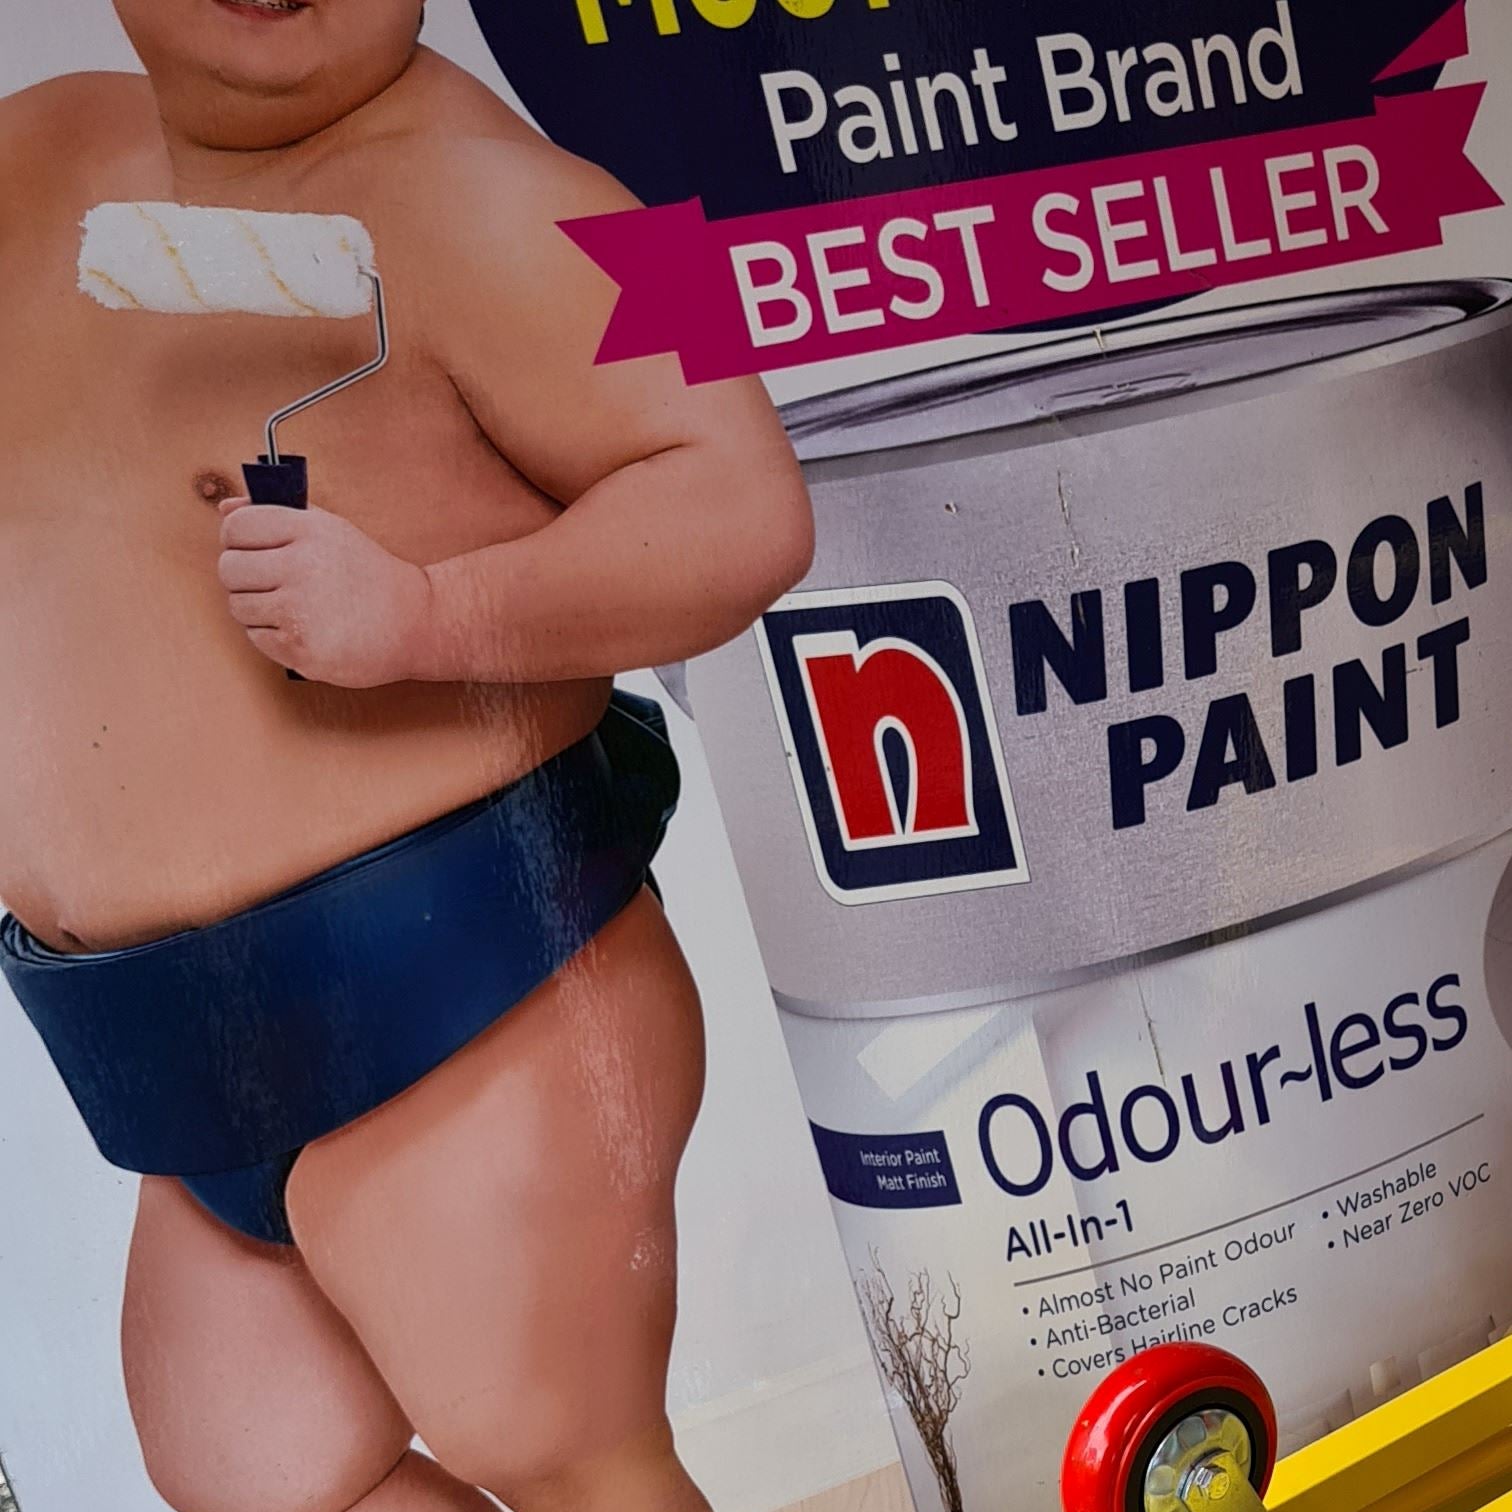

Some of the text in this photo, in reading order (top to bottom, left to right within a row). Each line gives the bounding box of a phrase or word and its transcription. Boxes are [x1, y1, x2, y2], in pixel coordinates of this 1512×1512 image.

[760, 0, 1303, 172] Paint Brand
[728, 143, 1391, 348] BEST SELLER
[1008, 481, 1488, 716] NIPPON
[1106, 617, 1471, 830] PAINT
[859, 1148, 941, 1167] Interior Paint
[875, 1171, 947, 1191] Matt Finish
[1336, 1162, 1438, 1217] Washable
[1006, 1199, 1134, 1262] All-In-1
[1342, 1162, 1492, 1249] Near Zero VOC
[1038, 1222, 1296, 1319] Almost No Paint Odour
[1046, 1287, 1196, 1349] Anti-Bacterial
[1052, 1286, 1299, 1379] Covers Hairline Cracks
